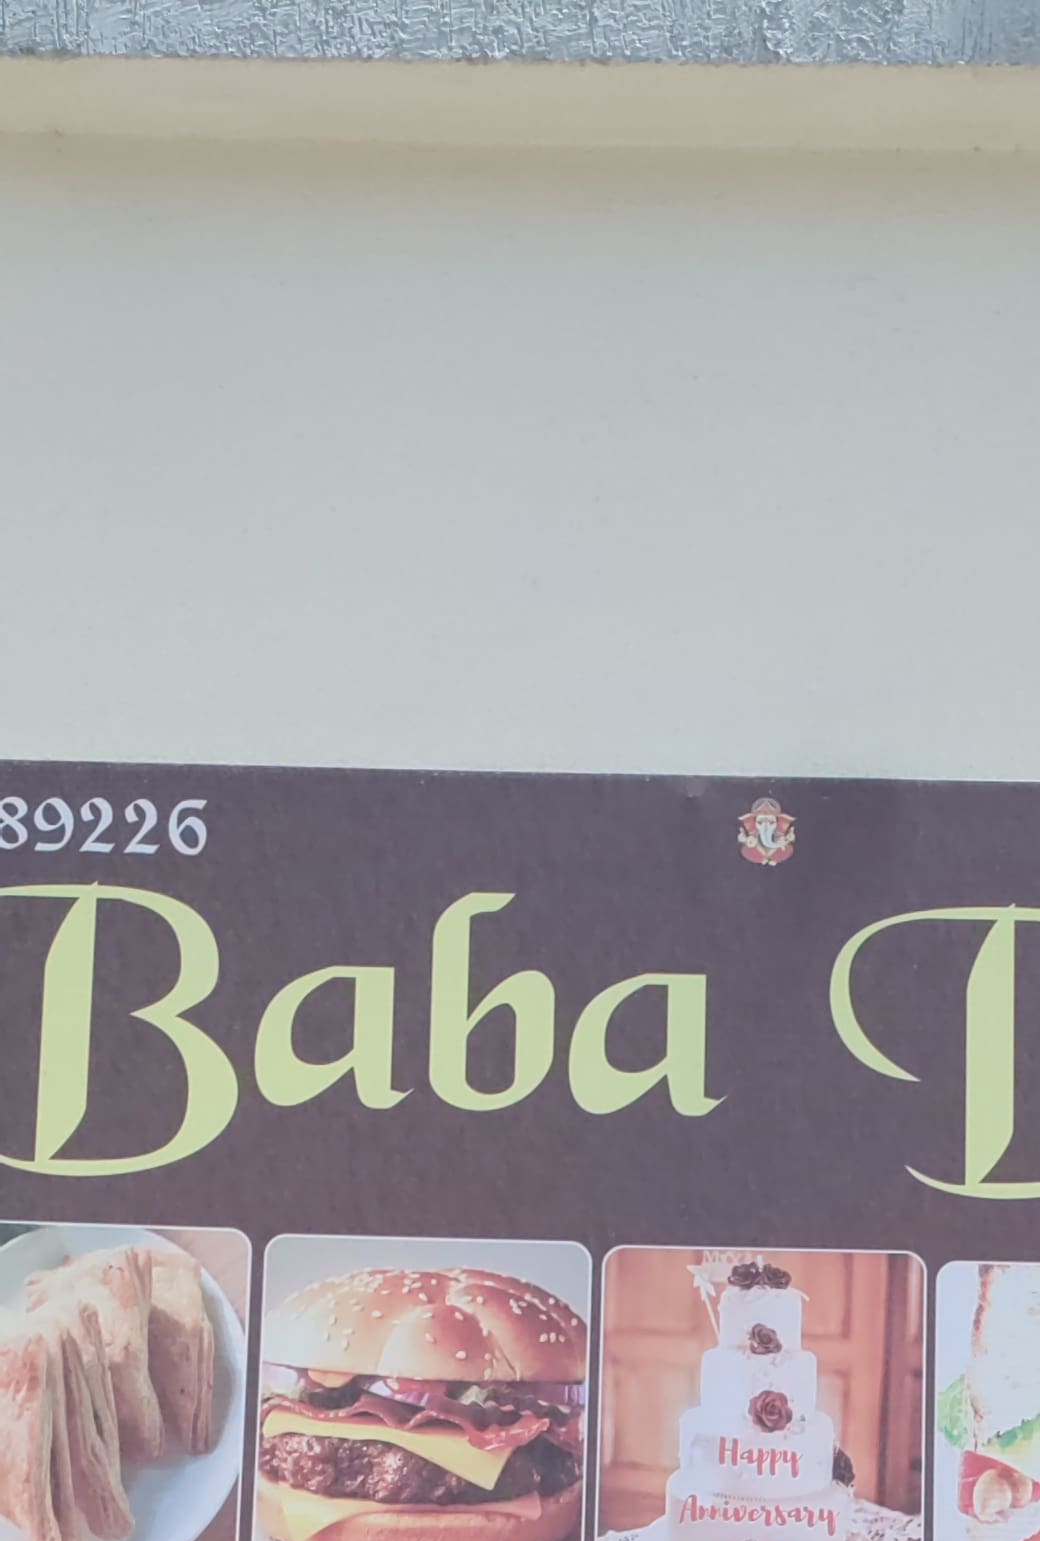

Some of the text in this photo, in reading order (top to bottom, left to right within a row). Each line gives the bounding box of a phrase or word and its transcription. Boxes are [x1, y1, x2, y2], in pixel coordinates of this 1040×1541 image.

[0, 882, 727, 1176] Baba
[719, 1436, 804, 1478] Happy
[679, 1494, 840, 1536] Anniversary
